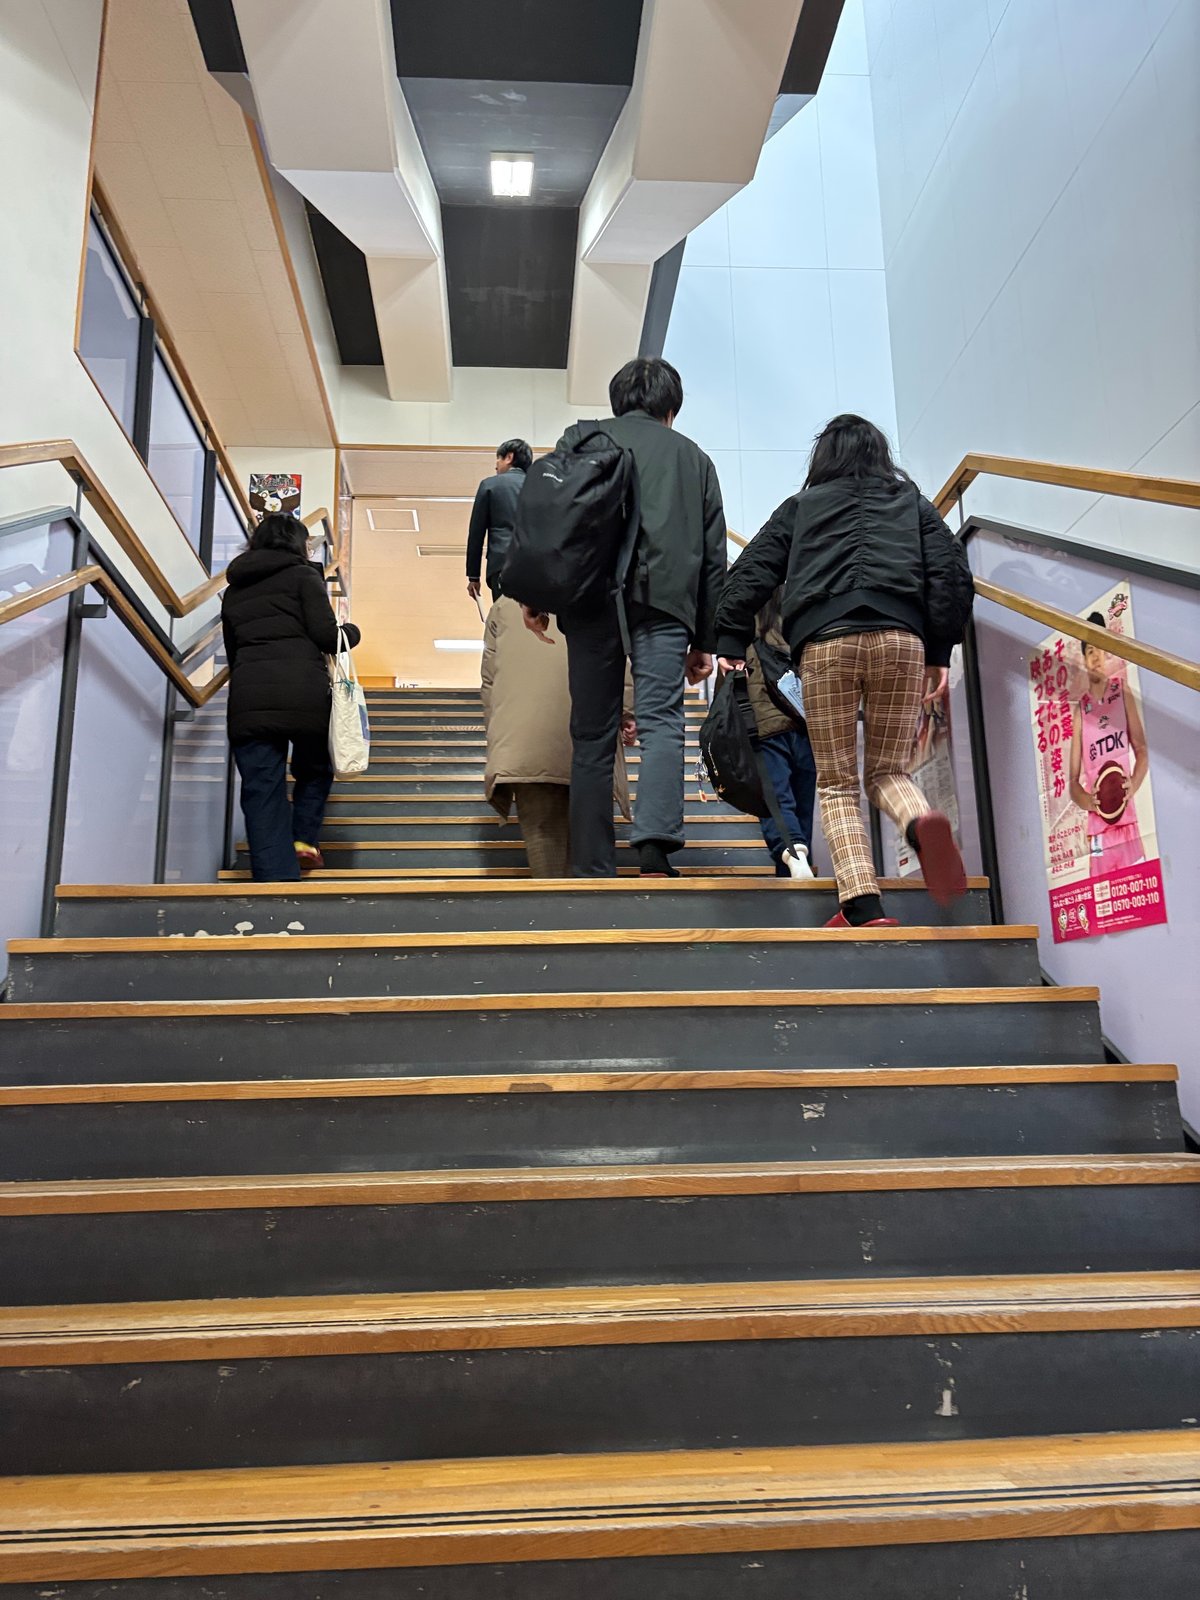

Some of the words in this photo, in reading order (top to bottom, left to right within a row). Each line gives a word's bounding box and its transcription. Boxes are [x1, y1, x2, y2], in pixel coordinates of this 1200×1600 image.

[1030, 657, 1047, 753] 映ってる
[1055, 639, 1073, 741] その言葉
[1043, 649, 1065, 798] あなたの姿が
[1096, 731, 1124, 756] TDK
[1111, 876, 1158, 898] 0120-007-110
[1113, 892, 1160, 912] 0570-003-110
